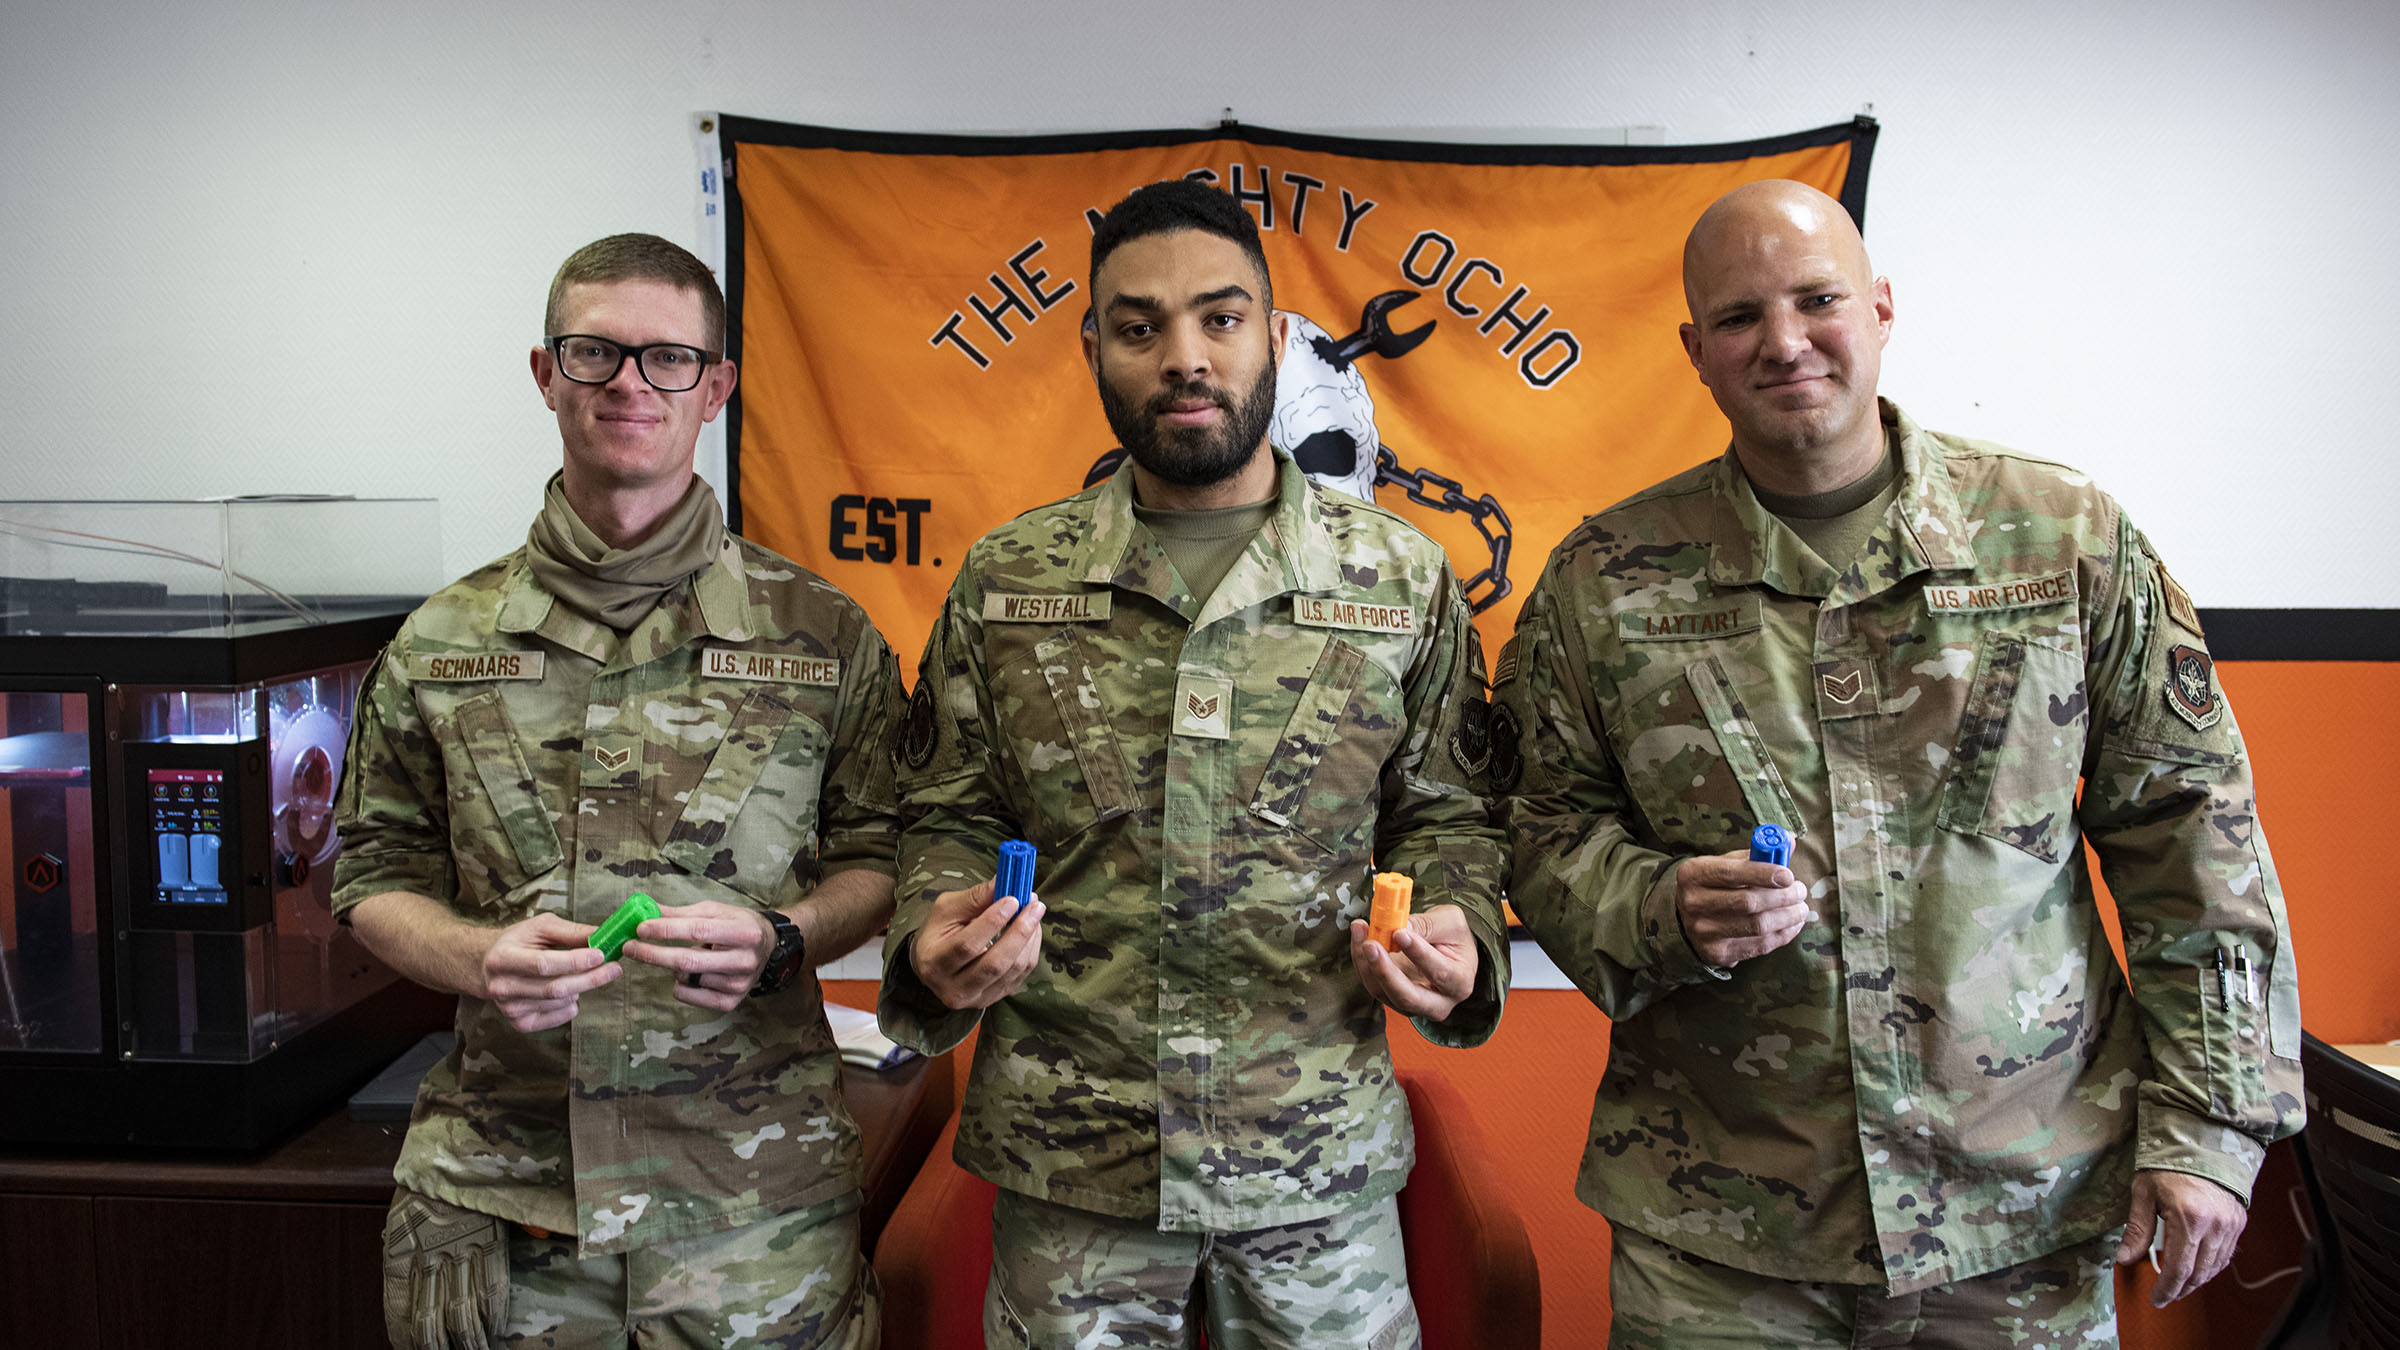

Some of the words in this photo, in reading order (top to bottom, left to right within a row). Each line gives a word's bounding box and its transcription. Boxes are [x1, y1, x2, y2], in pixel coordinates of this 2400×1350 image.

[928, 237, 1078, 372] THE
[1083, 163, 1378, 253] HTY
[1399, 229, 1582, 390] OCHO
[829, 493, 942, 566] EST.
[1968, 587, 2000, 608] AIR
[2003, 575, 2069, 605] FORCE
[1004, 596, 1091, 618] WESTFALL
[1300, 599, 1327, 621] U.S.
[1333, 602, 1358, 624] AIR
[1360, 606, 1411, 629] FORCE
[1646, 607, 1741, 635] LAYTART
[429, 655, 521, 678] SCHNAARS
[711, 652, 739, 675] U.S.
[746, 655, 774, 677] AIR
[781, 658, 833, 682] FORCE
[1762, 826, 1783, 847] 8
